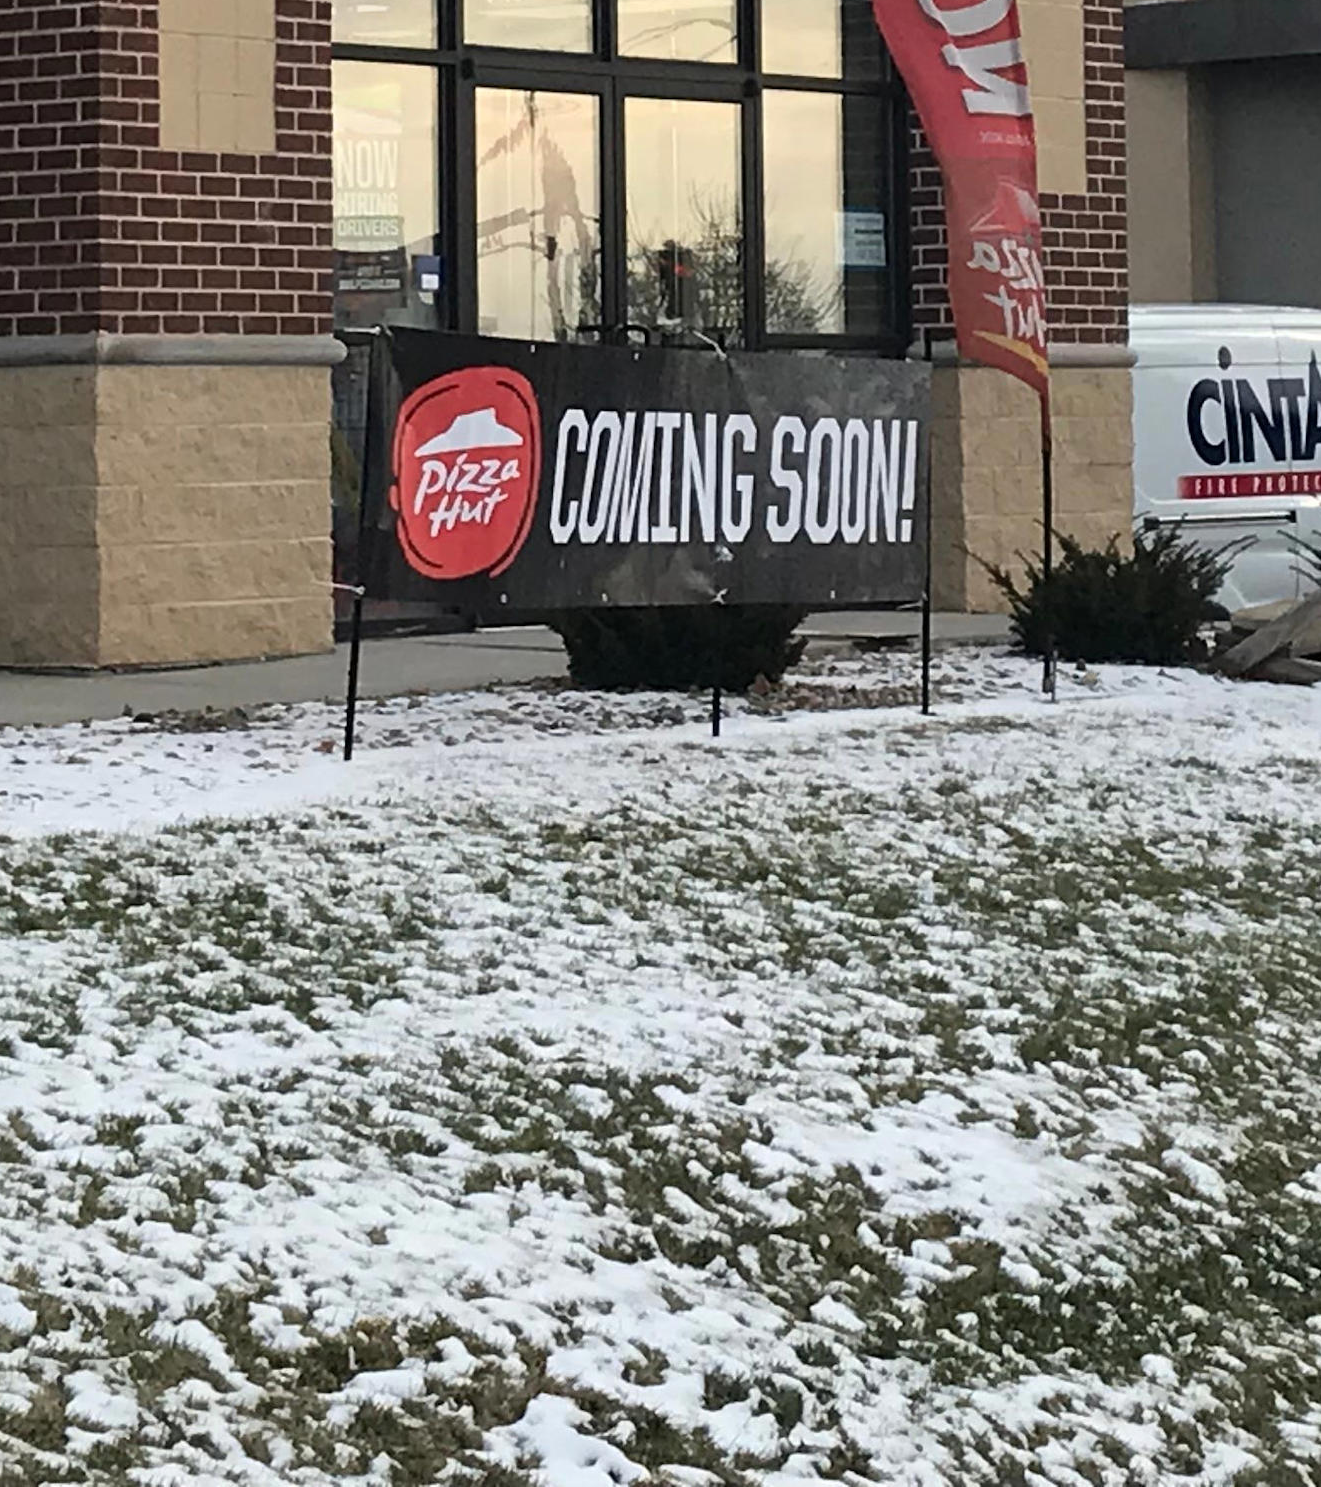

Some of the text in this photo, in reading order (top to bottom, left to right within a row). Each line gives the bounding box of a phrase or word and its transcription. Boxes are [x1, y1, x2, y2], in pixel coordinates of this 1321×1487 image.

[335, 138, 399, 190] NOW
[335, 190, 399, 217] HIRING
[336, 218, 400, 237] DRIVERS
[413, 453, 521, 516] Pizza
[549, 408, 919, 545] COMING SOON!
[1194, 476, 1238, 496] FIRE
[428, 487, 509, 538] Hut
